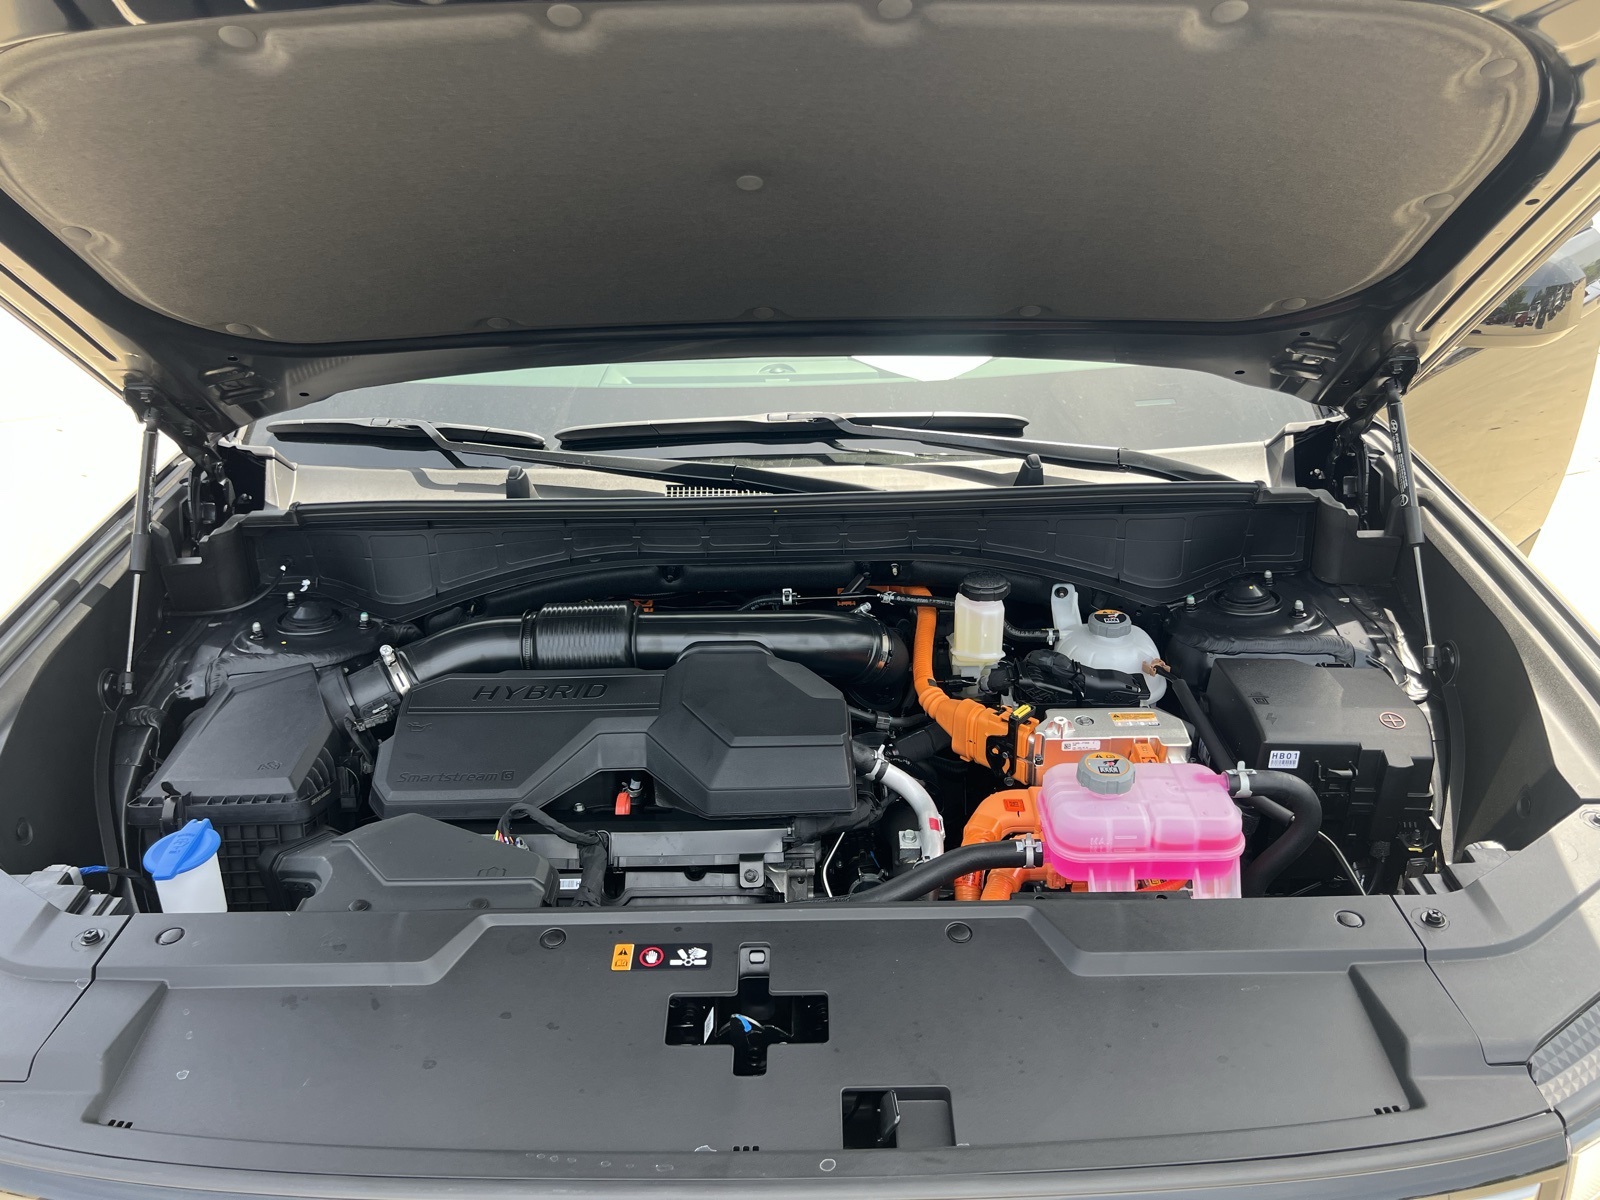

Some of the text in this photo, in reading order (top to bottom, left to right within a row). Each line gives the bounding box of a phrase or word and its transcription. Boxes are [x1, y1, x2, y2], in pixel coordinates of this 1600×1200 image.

[472, 683, 609, 701] HYBRID
[1271, 752, 1298, 760] HB01
[397, 771, 499, 782] Smartstream
